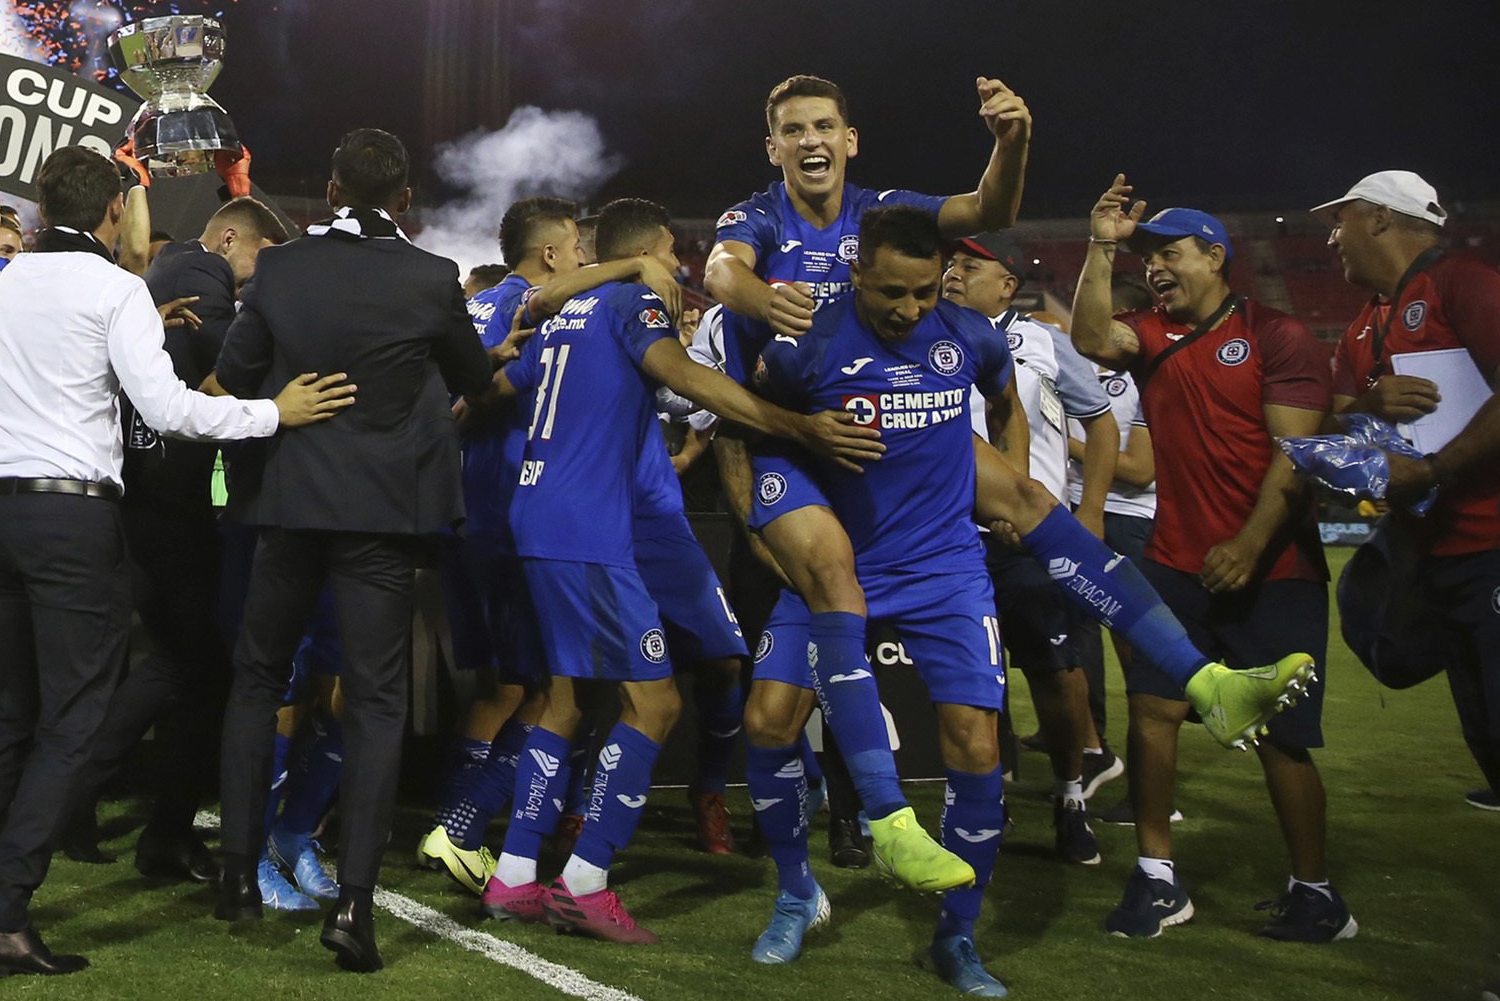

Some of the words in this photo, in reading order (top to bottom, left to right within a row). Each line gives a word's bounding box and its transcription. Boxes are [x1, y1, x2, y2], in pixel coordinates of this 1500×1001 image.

[6, 69, 122, 127] CUP
[880, 389, 963, 411] CEMENTO
[881, 411, 928, 429] CRUZ
[877, 642, 913, 665] CU
